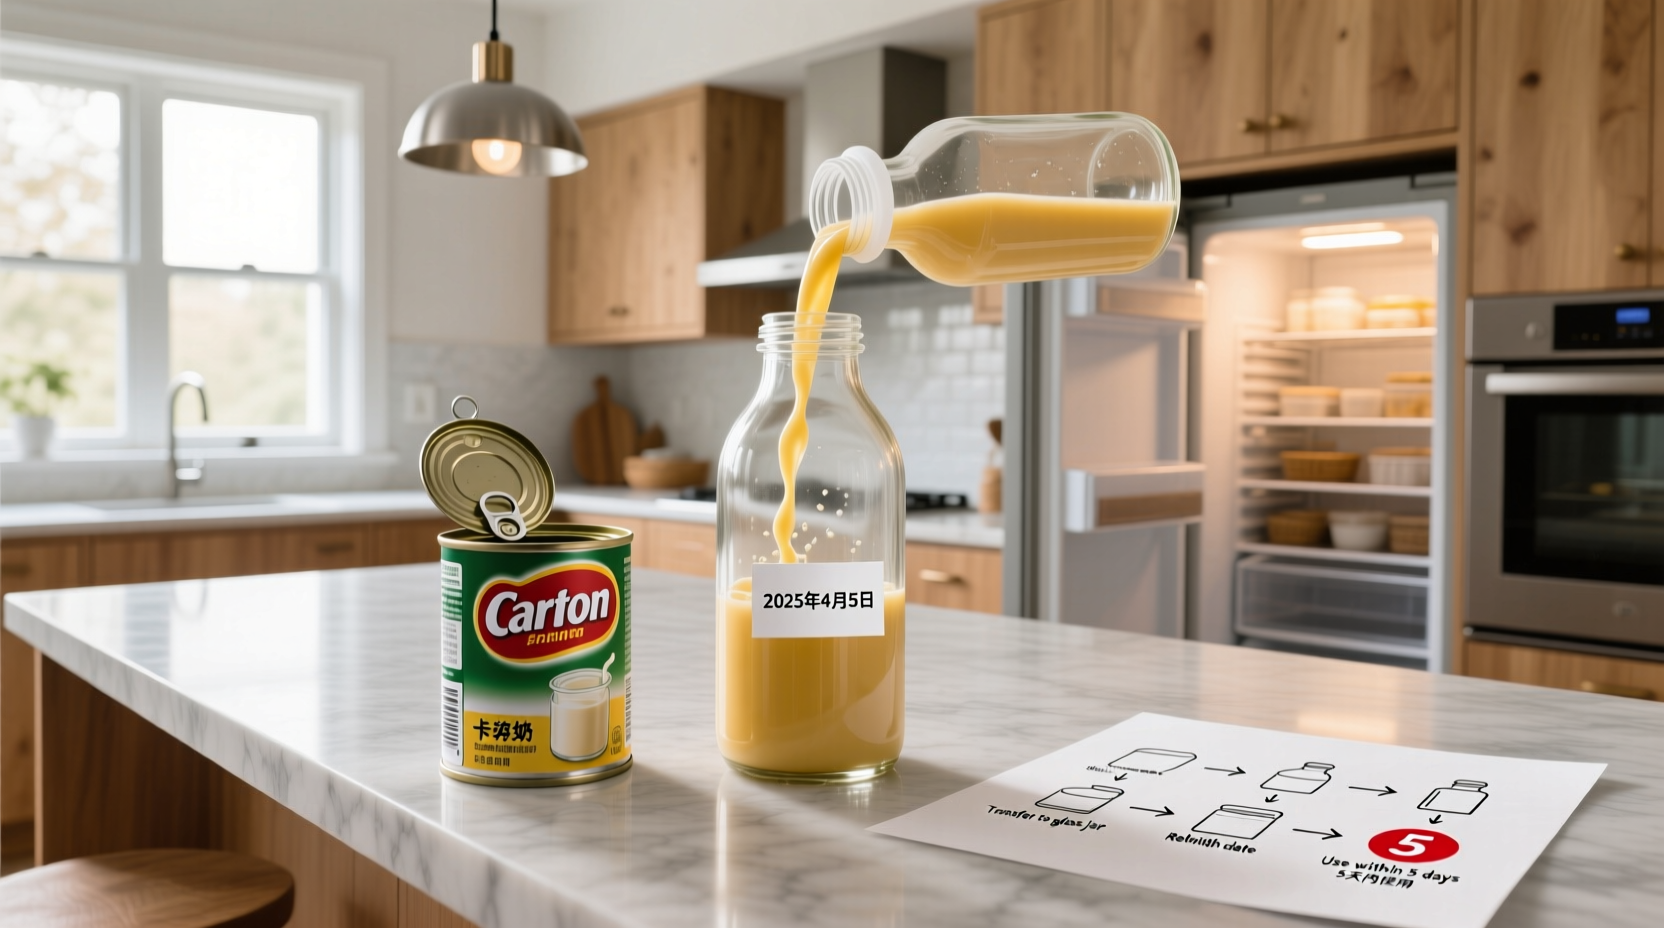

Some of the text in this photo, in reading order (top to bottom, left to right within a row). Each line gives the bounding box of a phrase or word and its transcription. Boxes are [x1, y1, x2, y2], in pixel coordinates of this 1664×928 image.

[485, 588, 610, 637] Carton
[763, 591, 873, 610] 2025年4月5日
[1388, 833, 1434, 856] 5
[1321, 856, 1460, 884] Use within 5 days
